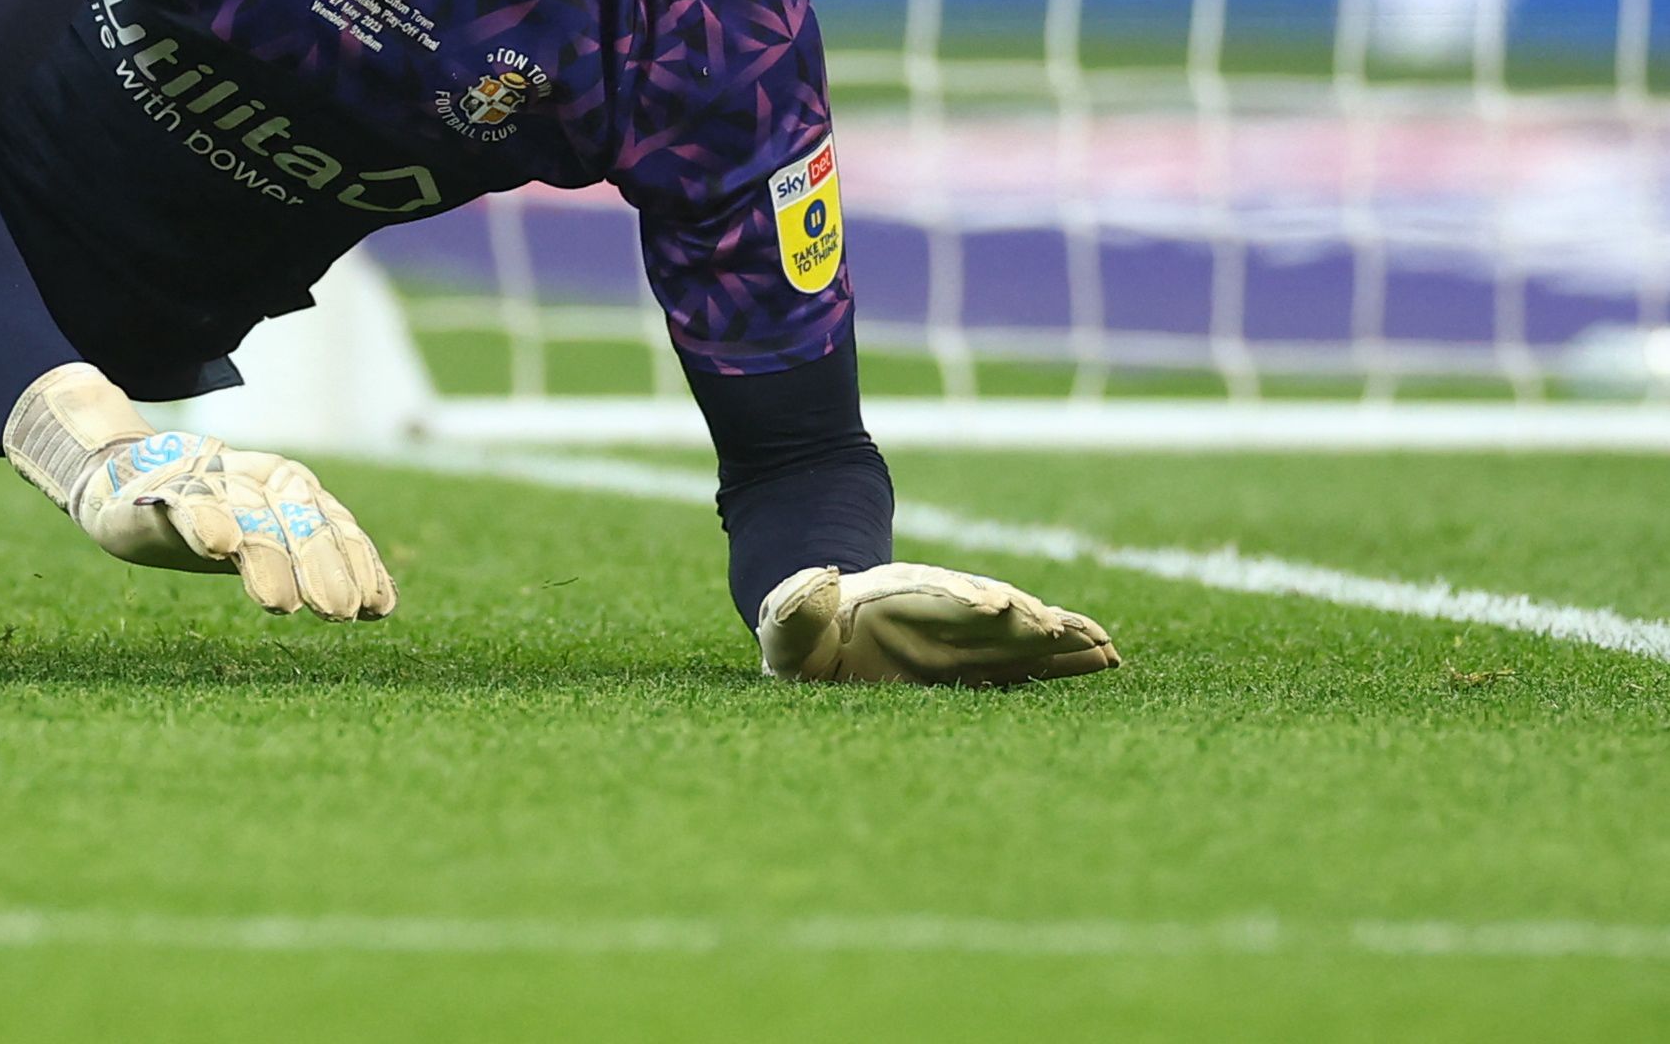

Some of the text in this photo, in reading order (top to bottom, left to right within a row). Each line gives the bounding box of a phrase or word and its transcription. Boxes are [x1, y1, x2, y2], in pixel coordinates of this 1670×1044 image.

[115, 59, 304, 206] with power
[435, 90, 518, 142] FOOTBALL CLUB
[777, 150, 831, 198] sky bet
[791, 241, 819, 266] TAKE
[796, 260, 812, 276] TO
